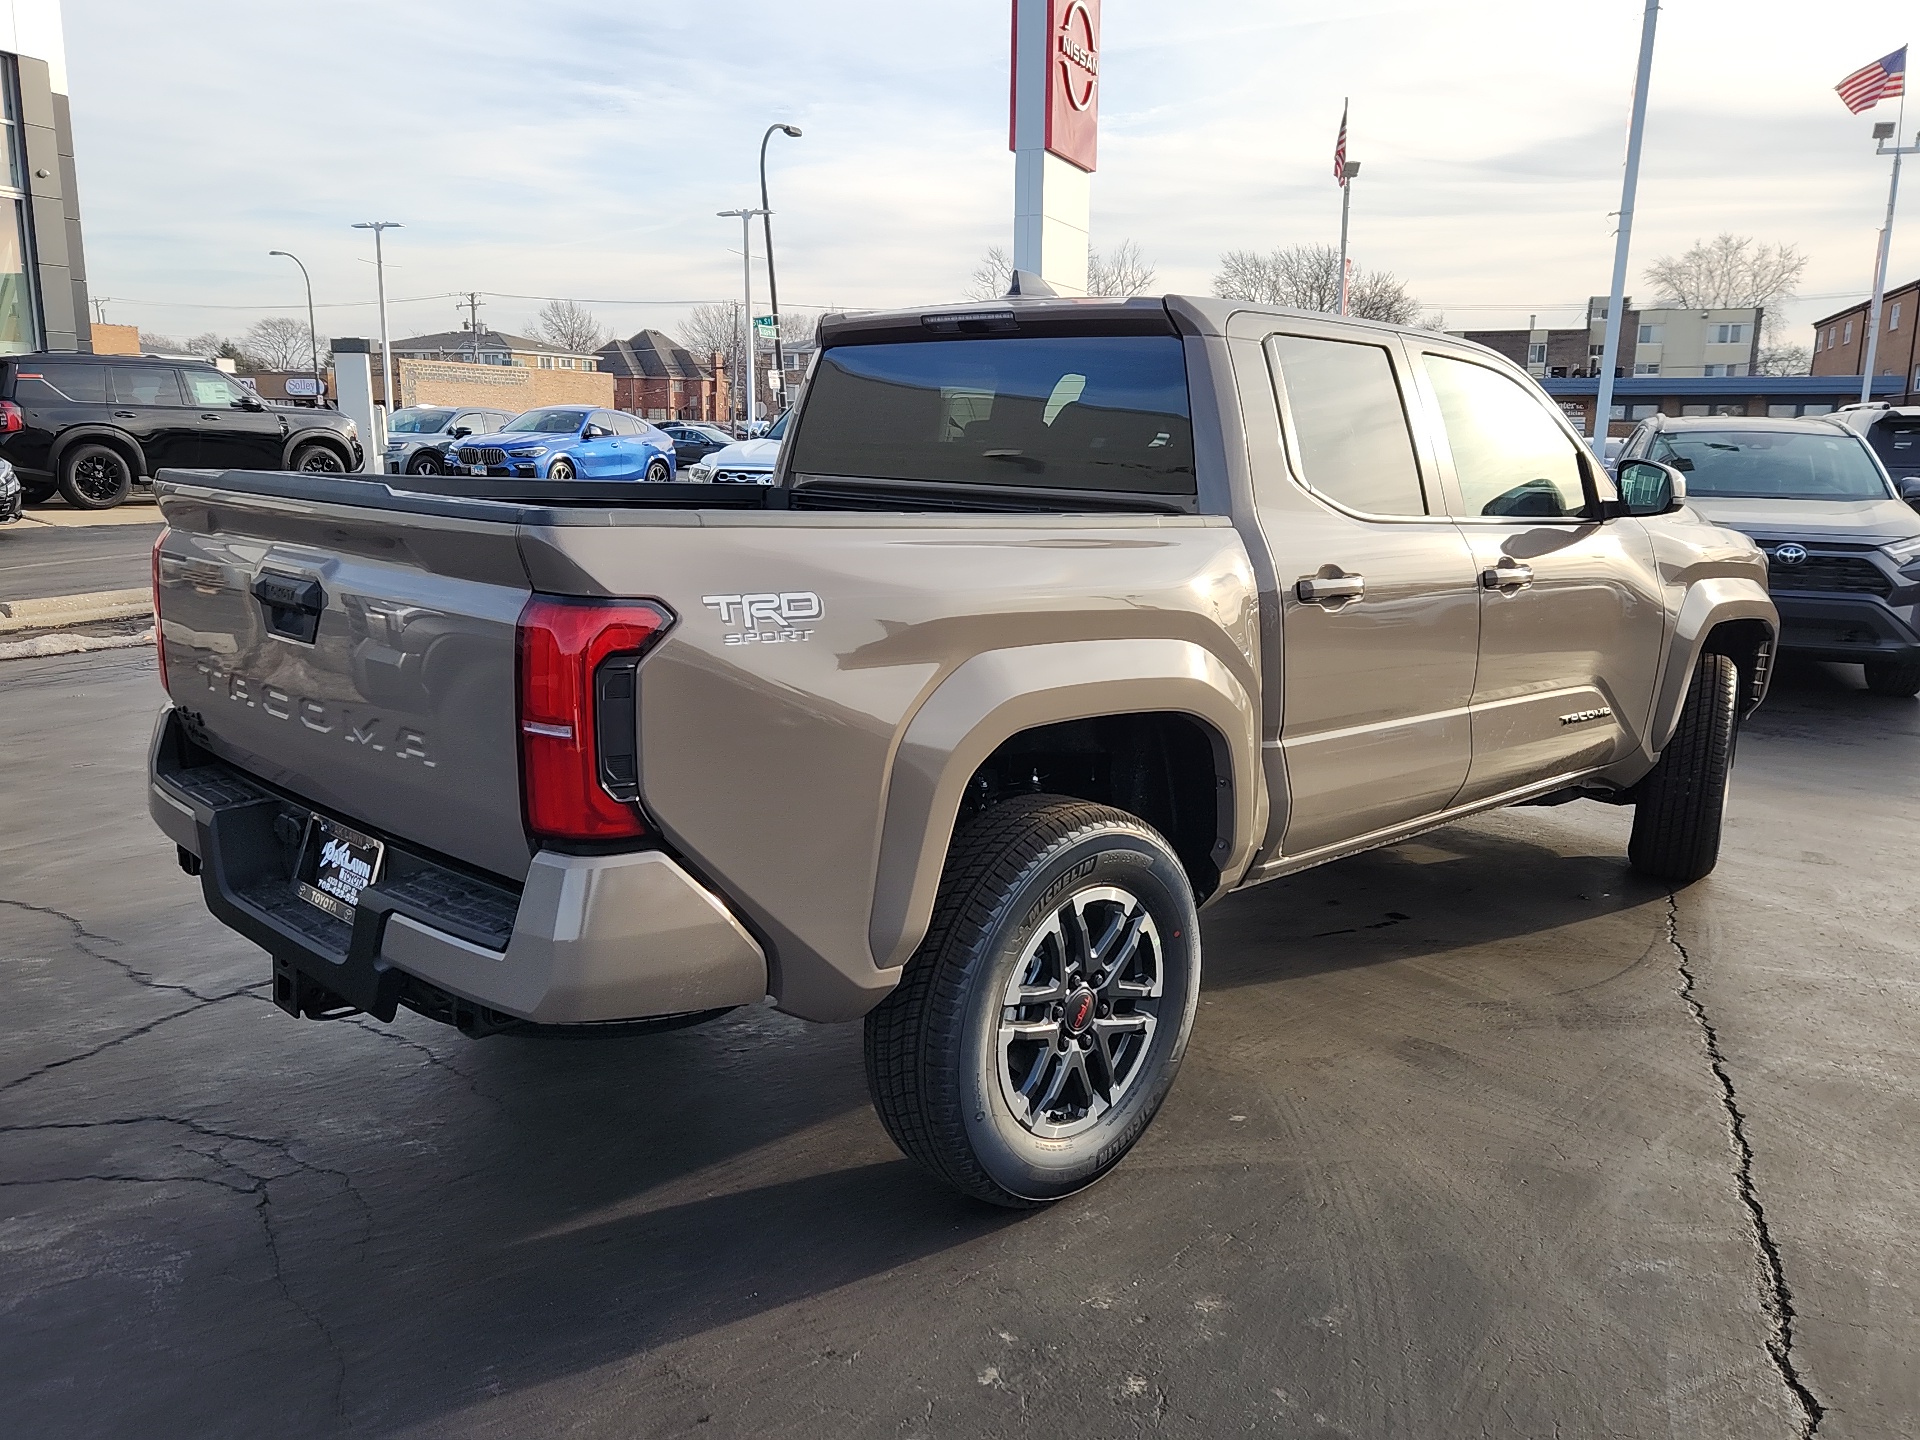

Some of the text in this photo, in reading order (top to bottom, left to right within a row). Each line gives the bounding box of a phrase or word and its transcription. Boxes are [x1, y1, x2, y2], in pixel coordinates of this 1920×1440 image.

[1061, 34, 1099, 76] NISSAN
[702, 591, 823, 630] TRD
[723, 629, 815, 646] SPORT
[197, 662, 437, 768] TACOMA
[1558, 706, 1612, 725] TACOMA
[343, 870, 364, 889] TOYOTA
[1028, 857, 1097, 924] MICHELIN
[310, 890, 338, 913] TOYOTA
[1075, 995, 1091, 1028] TRD
